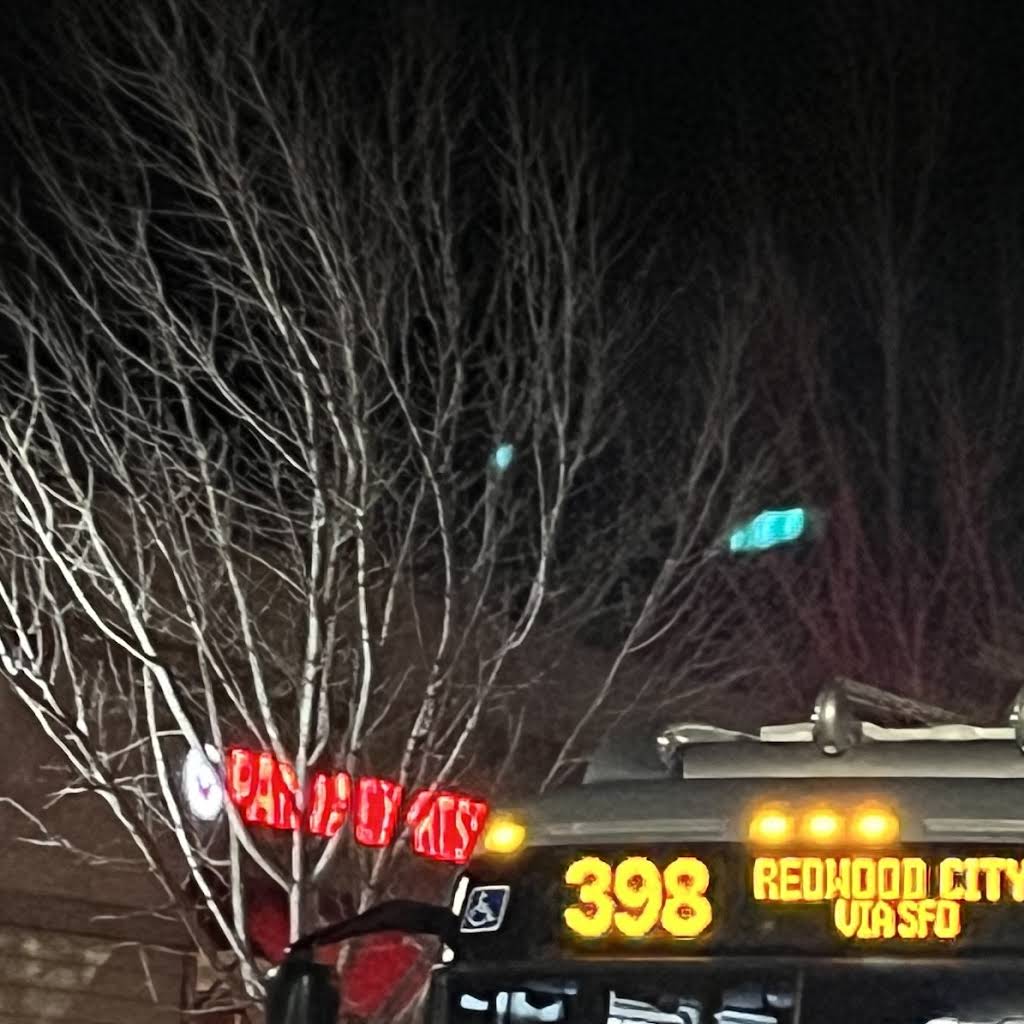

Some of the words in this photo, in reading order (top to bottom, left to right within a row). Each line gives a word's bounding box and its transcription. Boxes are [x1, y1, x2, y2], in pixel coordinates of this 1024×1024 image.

[563, 856, 713, 938] 398
[753, 856, 928, 900] REDWOOD
[834, 898, 896, 939] VIA
[897, 898, 961, 939] SFO
